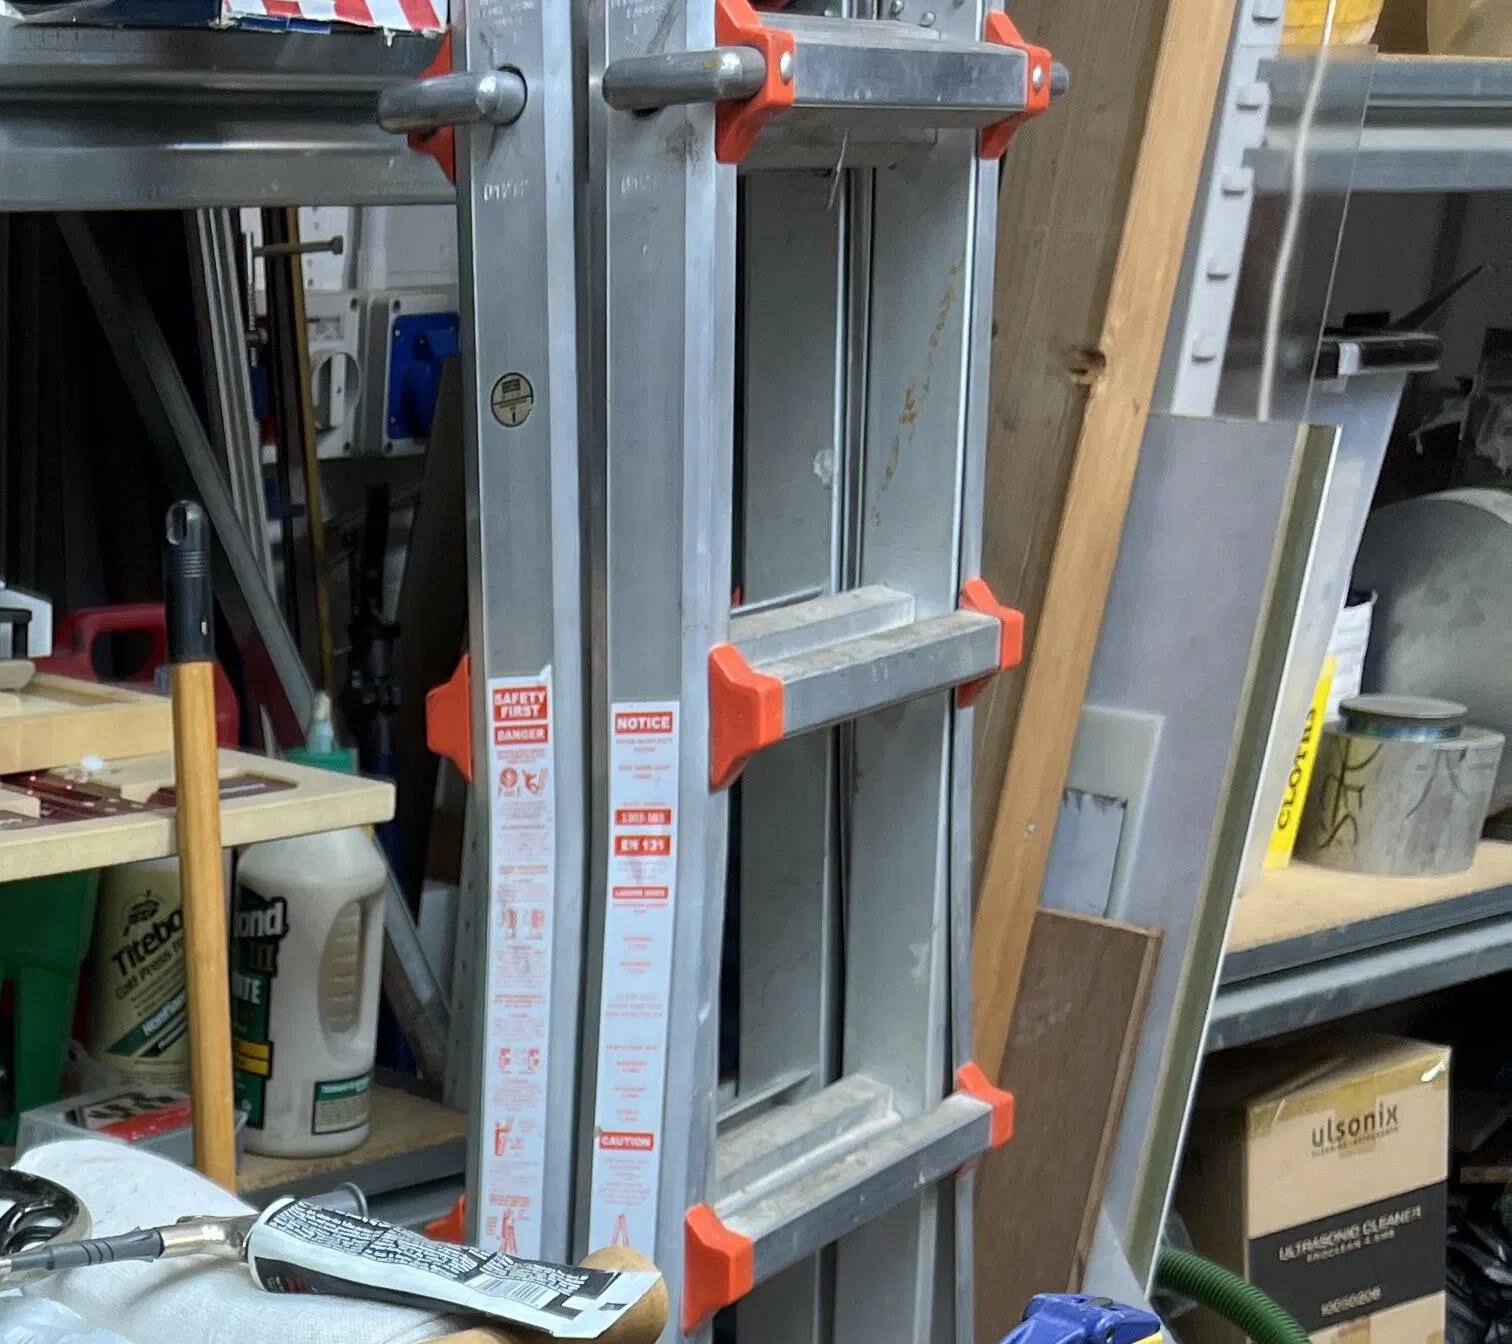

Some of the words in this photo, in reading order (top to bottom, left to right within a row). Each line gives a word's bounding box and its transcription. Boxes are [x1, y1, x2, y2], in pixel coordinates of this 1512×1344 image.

[494, 691, 545, 705] SAFETY
[501, 705, 540, 719] FIRST
[616, 716, 671, 730] NOTICE
[497, 727, 545, 741] DANGER
[1311, 1102, 1398, 1148] ulsonix
[602, 1135, 651, 1148] CAUTION
[1278, 1224, 1361, 1261] ULTRASONIC
[1362, 1205, 1422, 1235] CLEANER
